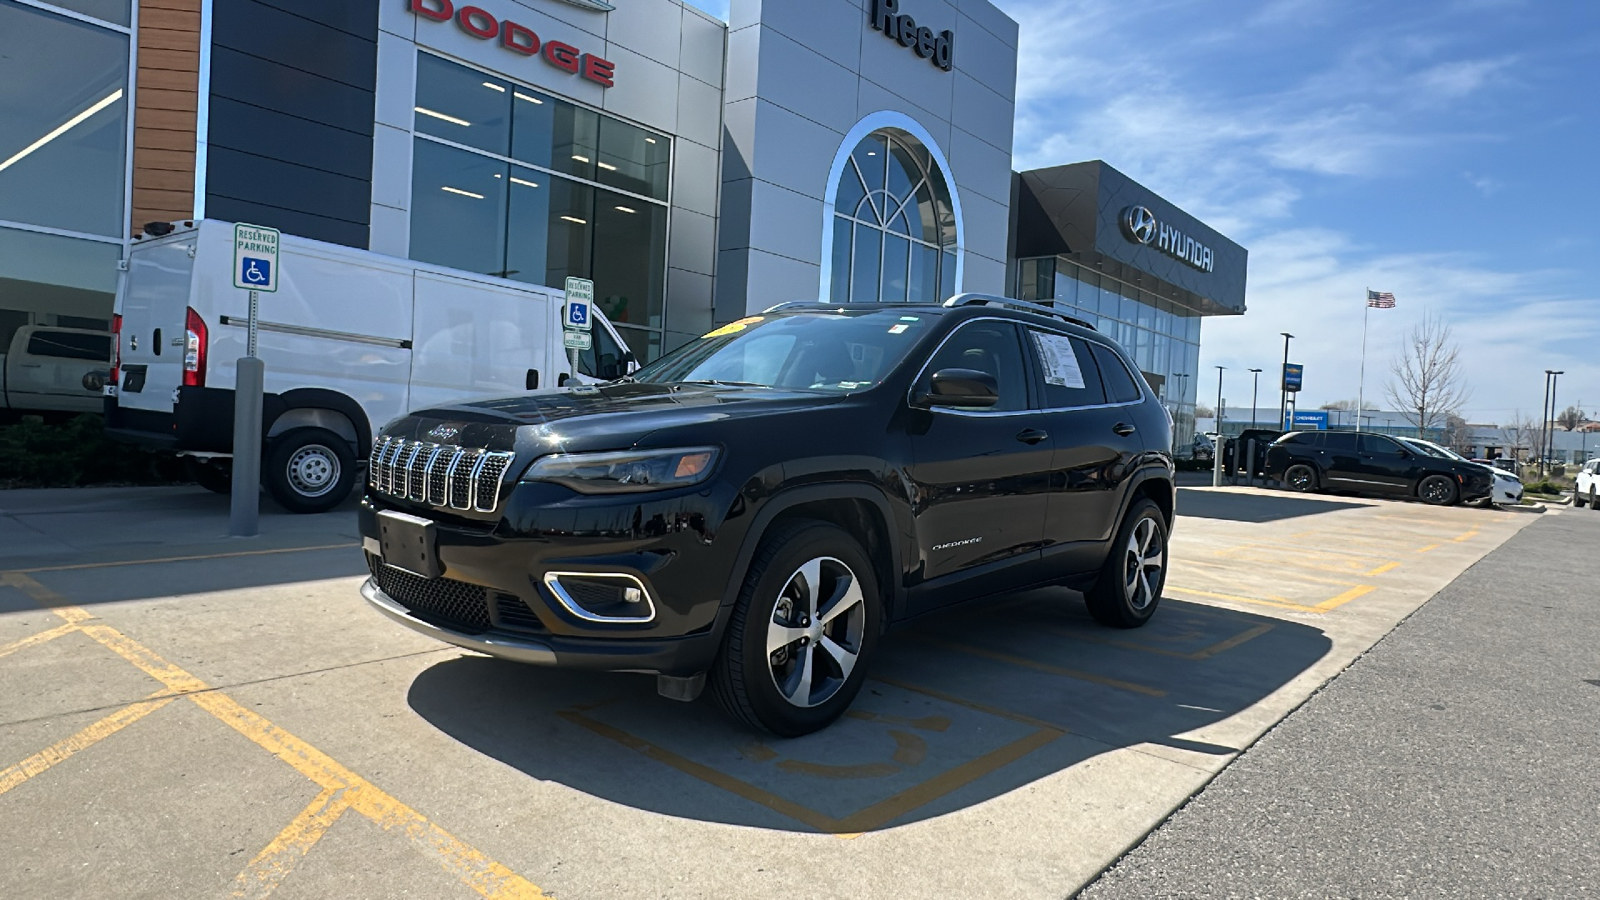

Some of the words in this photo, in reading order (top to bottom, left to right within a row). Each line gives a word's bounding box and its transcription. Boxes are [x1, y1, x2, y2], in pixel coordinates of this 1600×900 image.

[408, 0, 615, 88] DODGE
[871, 0, 954, 71] Reed
[238, 229, 276, 244] RESERVED
[238, 241, 276, 255] PARKING
[1159, 221, 1214, 273] HYUNDAI
